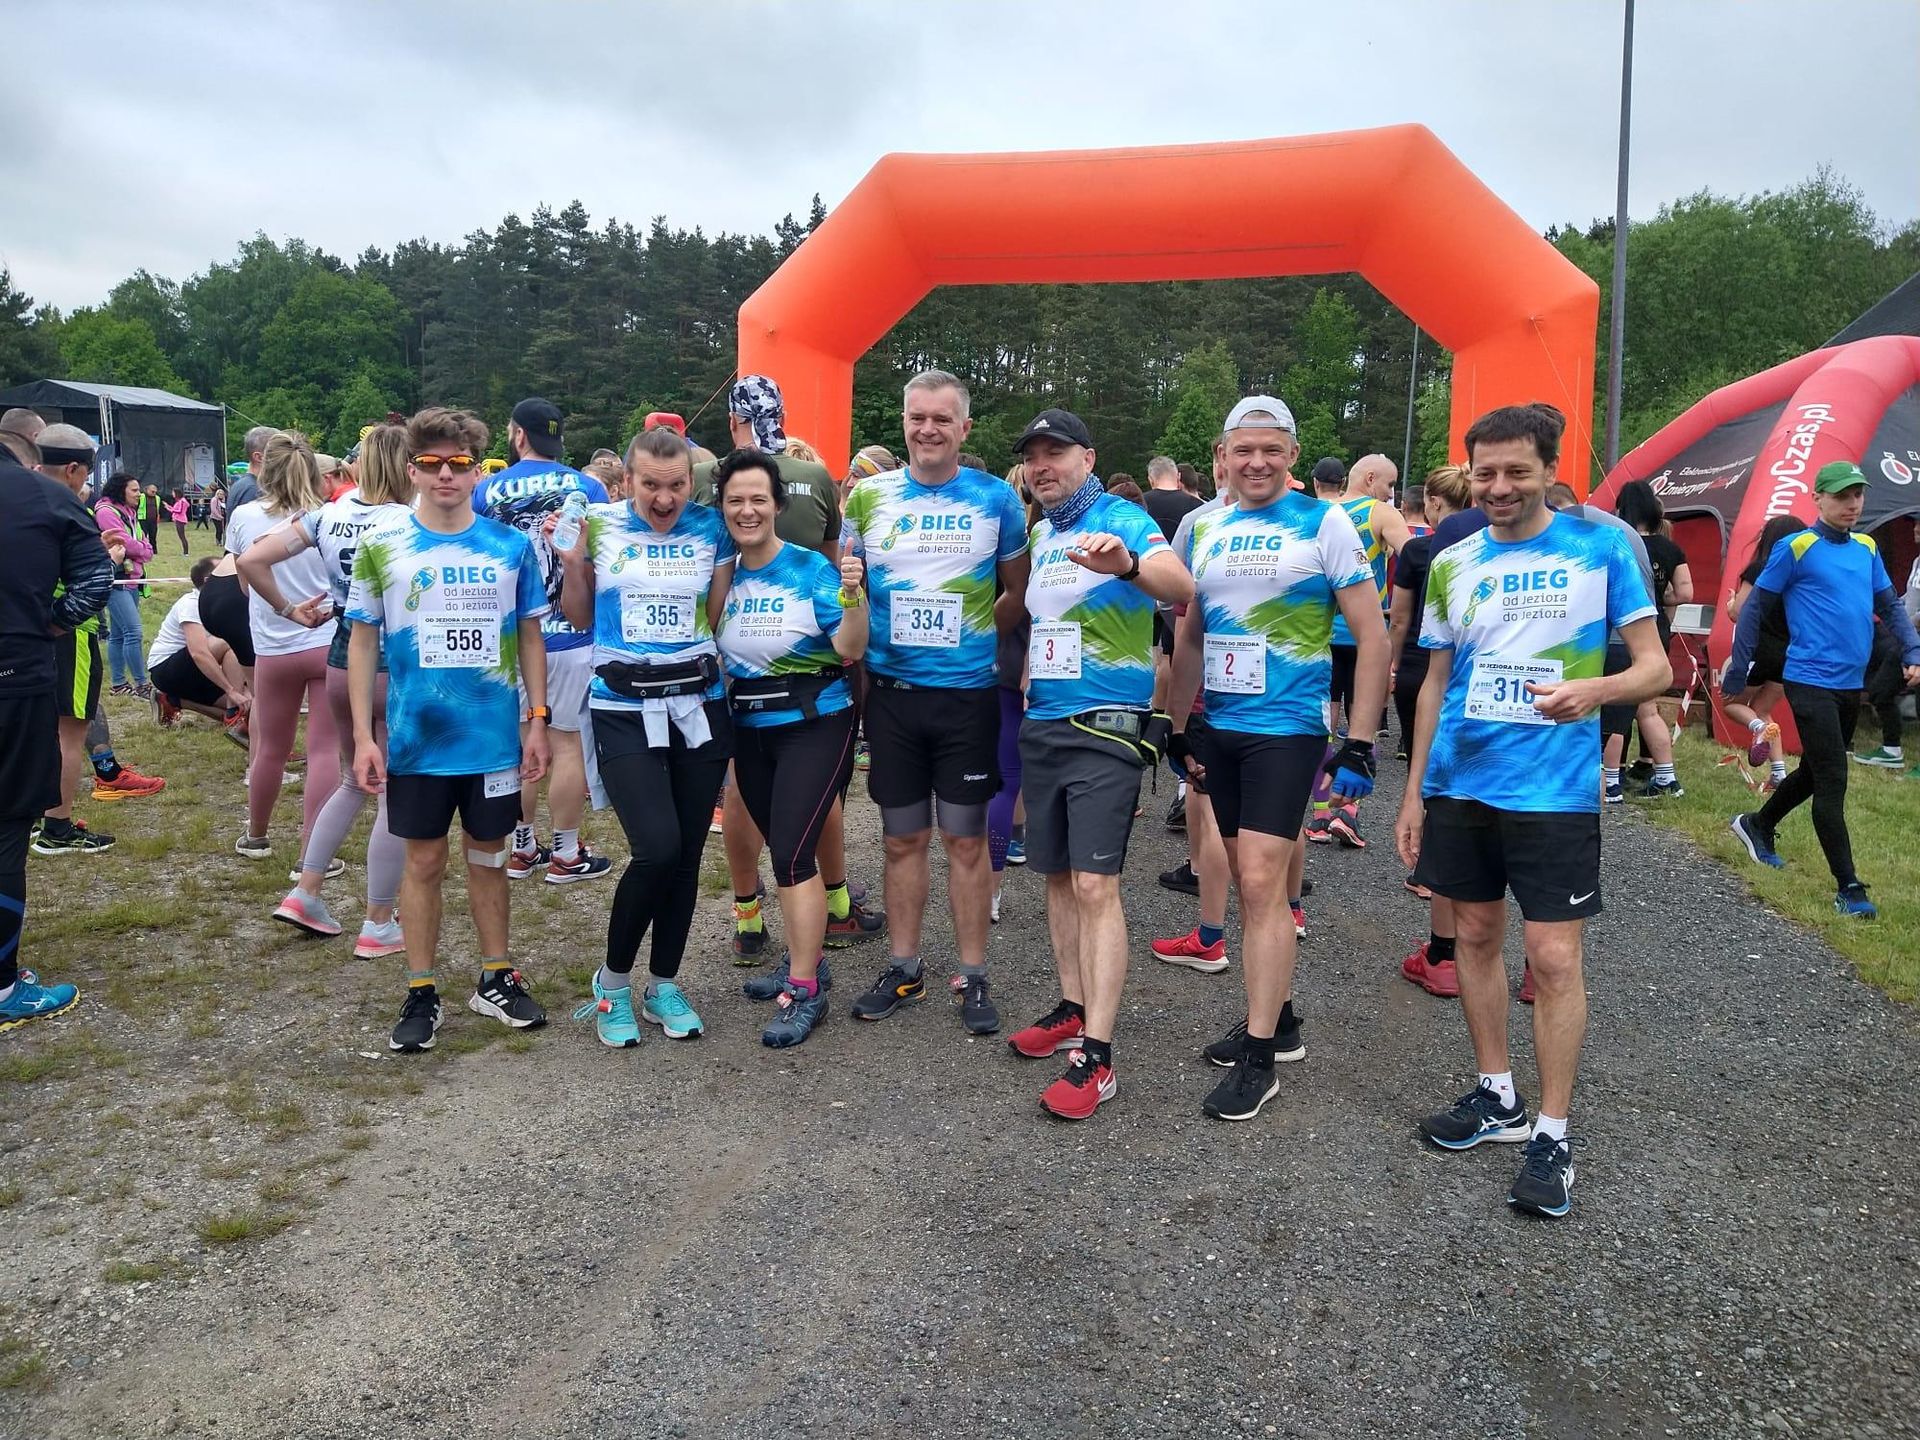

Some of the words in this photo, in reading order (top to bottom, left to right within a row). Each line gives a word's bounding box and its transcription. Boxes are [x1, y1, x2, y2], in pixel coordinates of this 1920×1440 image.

[921, 514, 973, 530] BIEG
[919, 532, 932, 541] Od
[935, 532, 972, 541] Jeziora
[1229, 535, 1282, 552] BIEG
[647, 544, 695, 559] BIEG
[917, 545, 930, 553] do
[933, 544, 971, 554] Jeziora
[1227, 554, 1239, 564] Od
[1241, 553, 1279, 563] Jeziora
[442, 566, 497, 584] BIEG
[648, 569, 661, 577] do
[1225, 568, 1237, 577] do
[1239, 566, 1277, 577] Jeziora
[1503, 569, 1569, 594] BIEG
[443, 586, 458, 597] Od
[461, 586, 497, 597] Jeziora
[445, 601, 458, 611] do
[461, 601, 498, 611] Jeziora
[742, 597, 784, 613] BIEG
[1502, 595, 1518, 607] Od
[1521, 593, 1567, 605] Jeziora
[646, 604, 679, 626] 355
[740, 616, 750, 625] Od
[752, 616, 783, 624] Jeziora
[911, 608, 944, 631] 334
[1503, 610, 1518, 622] do
[1521, 608, 1566, 620] Jeziora
[739, 628, 748, 637] do
[750, 628, 782, 637] Jeziora
[446, 629, 483, 651] 558
[1046, 639, 1054, 661] 3
[1225, 652, 1234, 675] 2
[1486, 663, 1512, 671] JEZIORA
